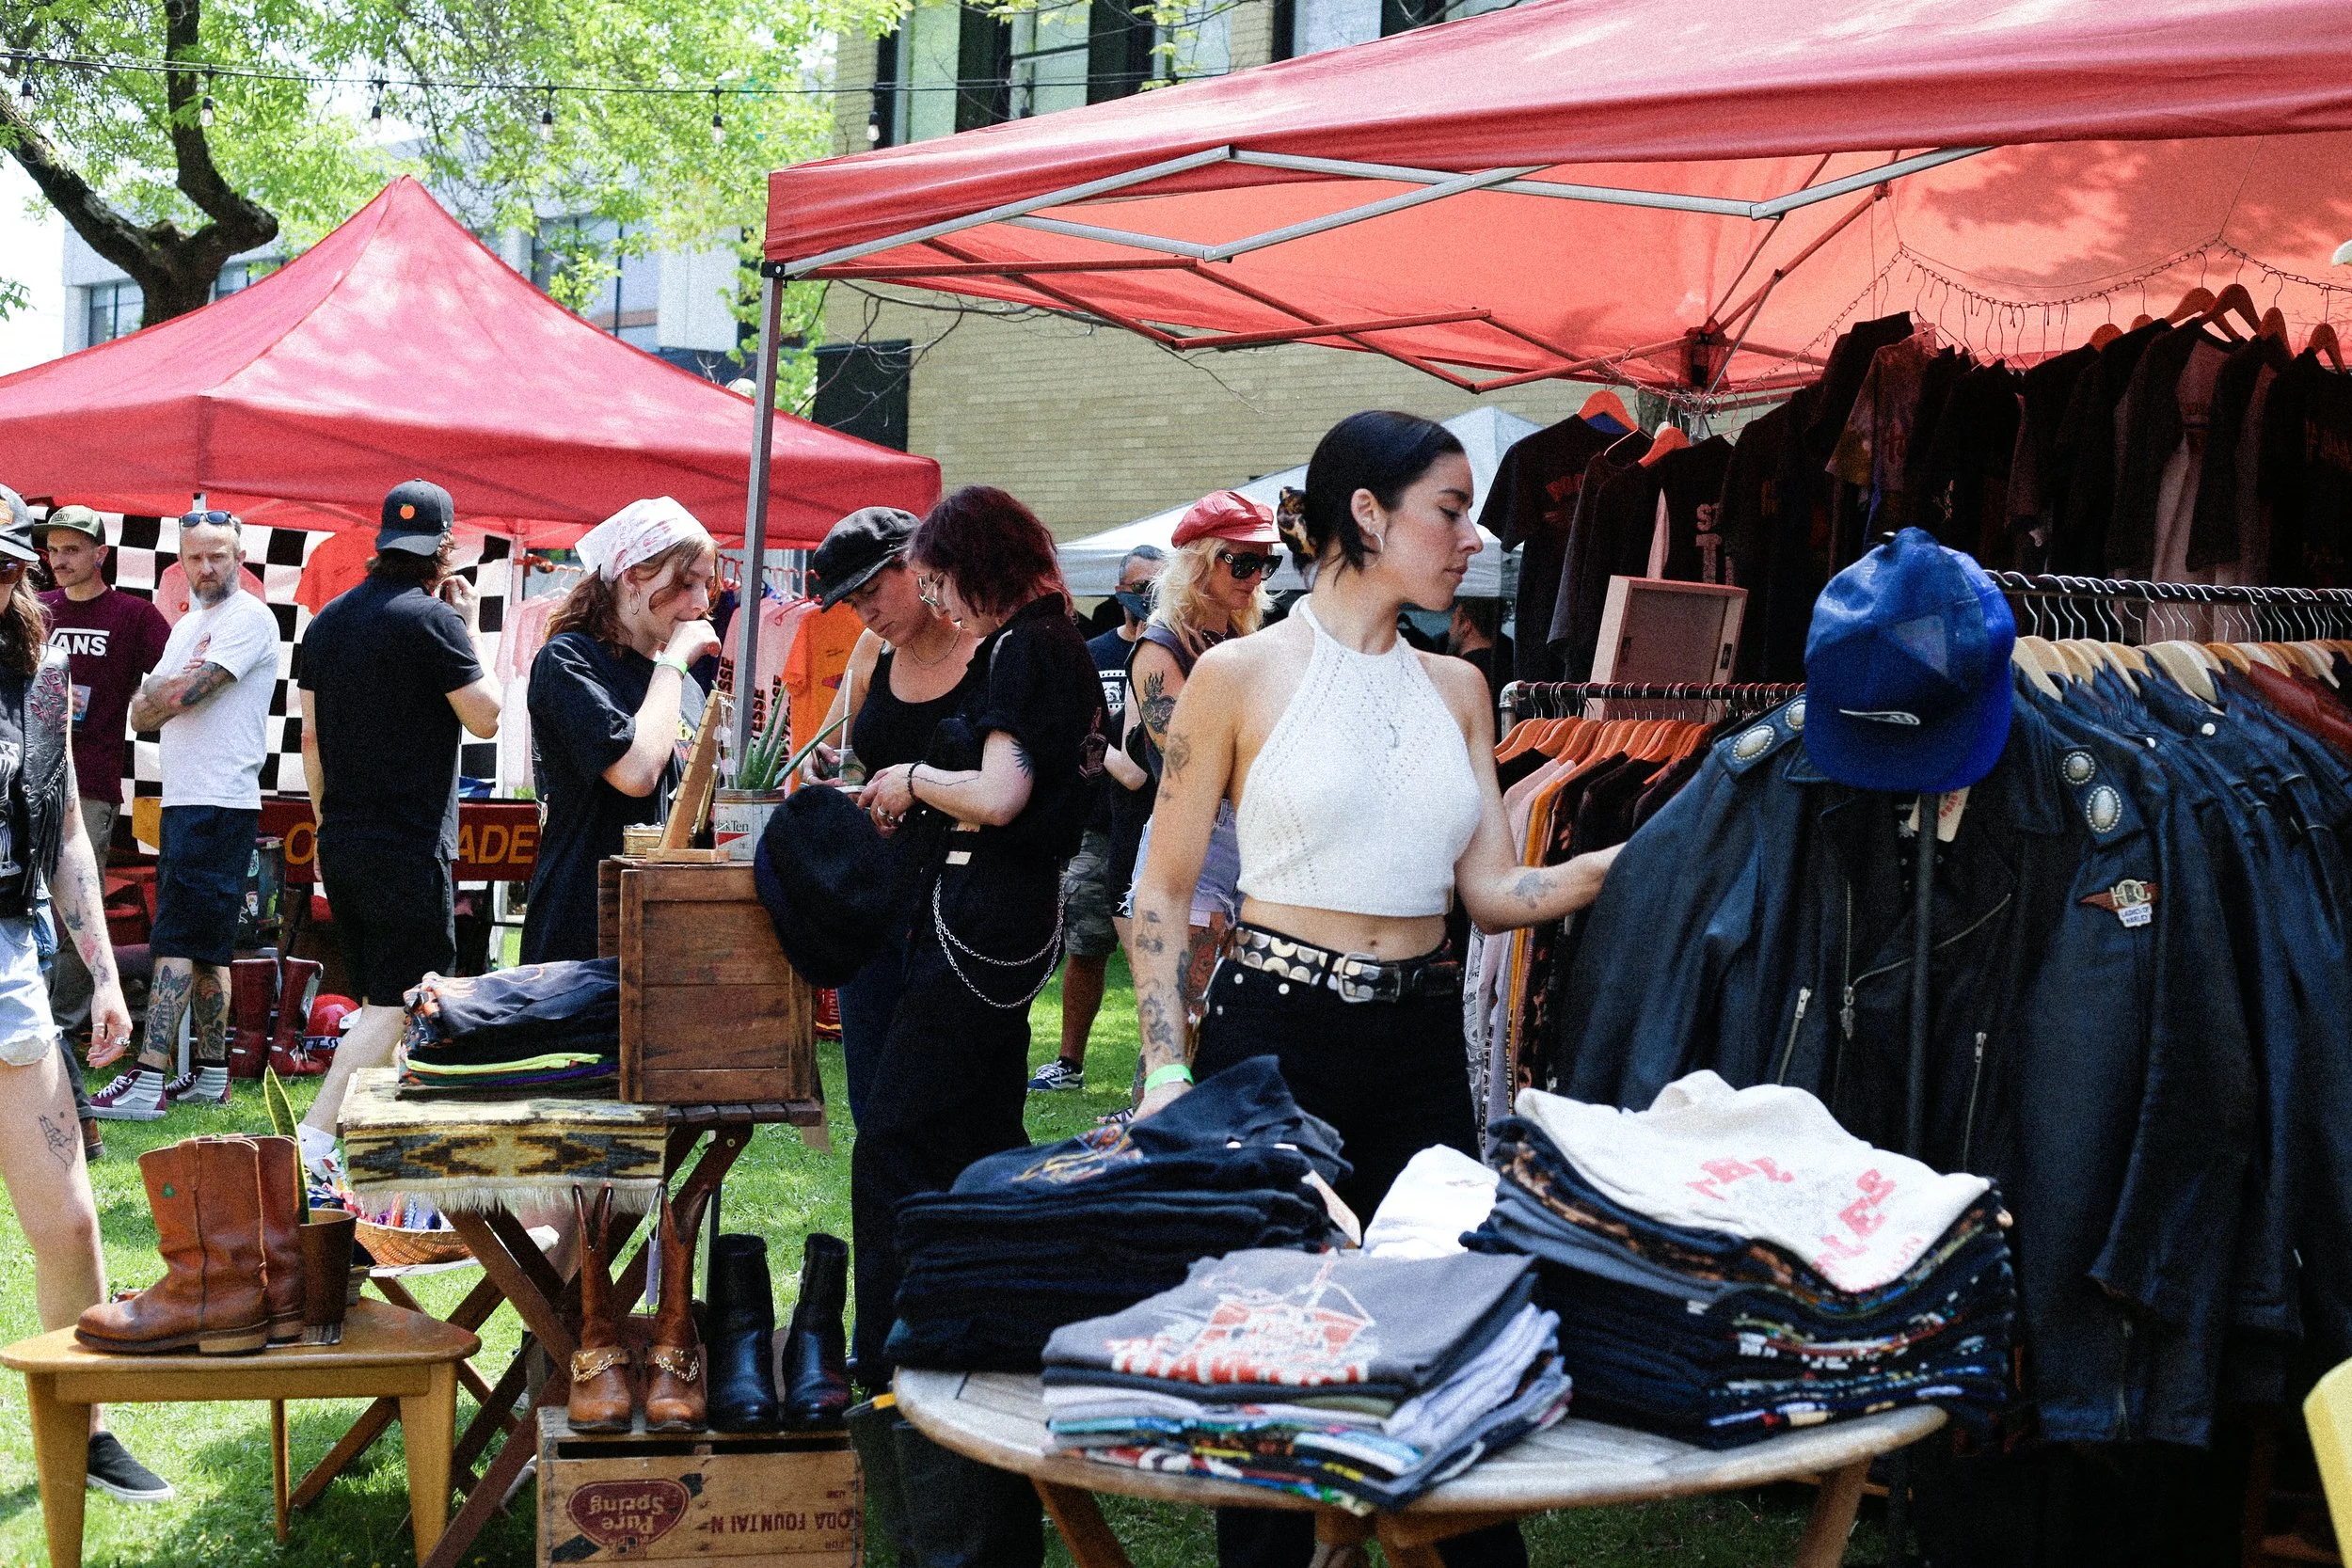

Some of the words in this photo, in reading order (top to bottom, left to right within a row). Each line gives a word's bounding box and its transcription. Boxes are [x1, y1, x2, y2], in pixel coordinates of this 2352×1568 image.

[731, 819, 749, 832] Ten
[589, 1494, 666, 1516] Spring
[600, 1514, 655, 1534] Pure
